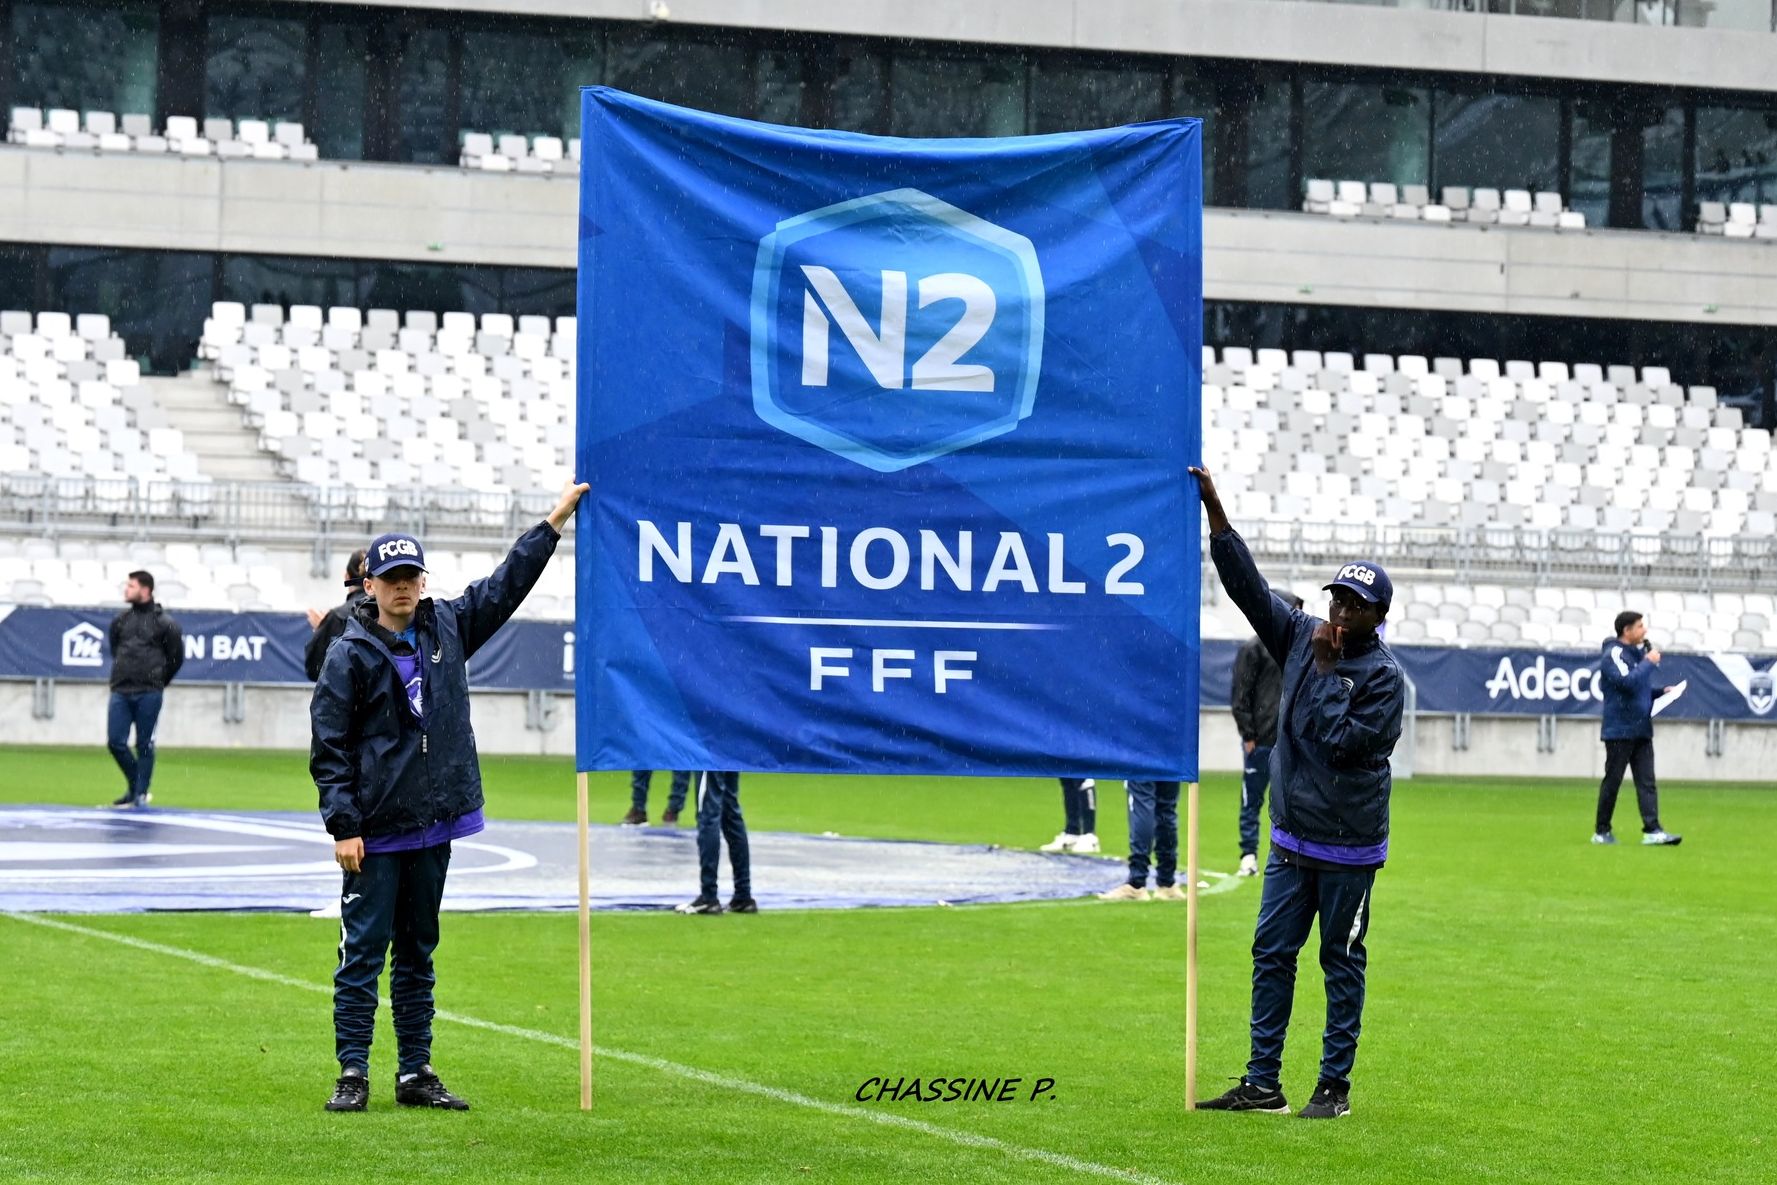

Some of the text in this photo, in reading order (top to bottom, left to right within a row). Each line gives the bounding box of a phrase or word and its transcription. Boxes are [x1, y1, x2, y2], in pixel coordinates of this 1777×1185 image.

[800, 265, 996, 392] N2
[378, 539, 418, 561] FCGB
[637, 520, 1145, 595] NATIONAL 2
[1338, 564, 1376, 586] FCGB
[181, 634, 267, 661] N BAT
[810, 647, 977, 694] FFF
